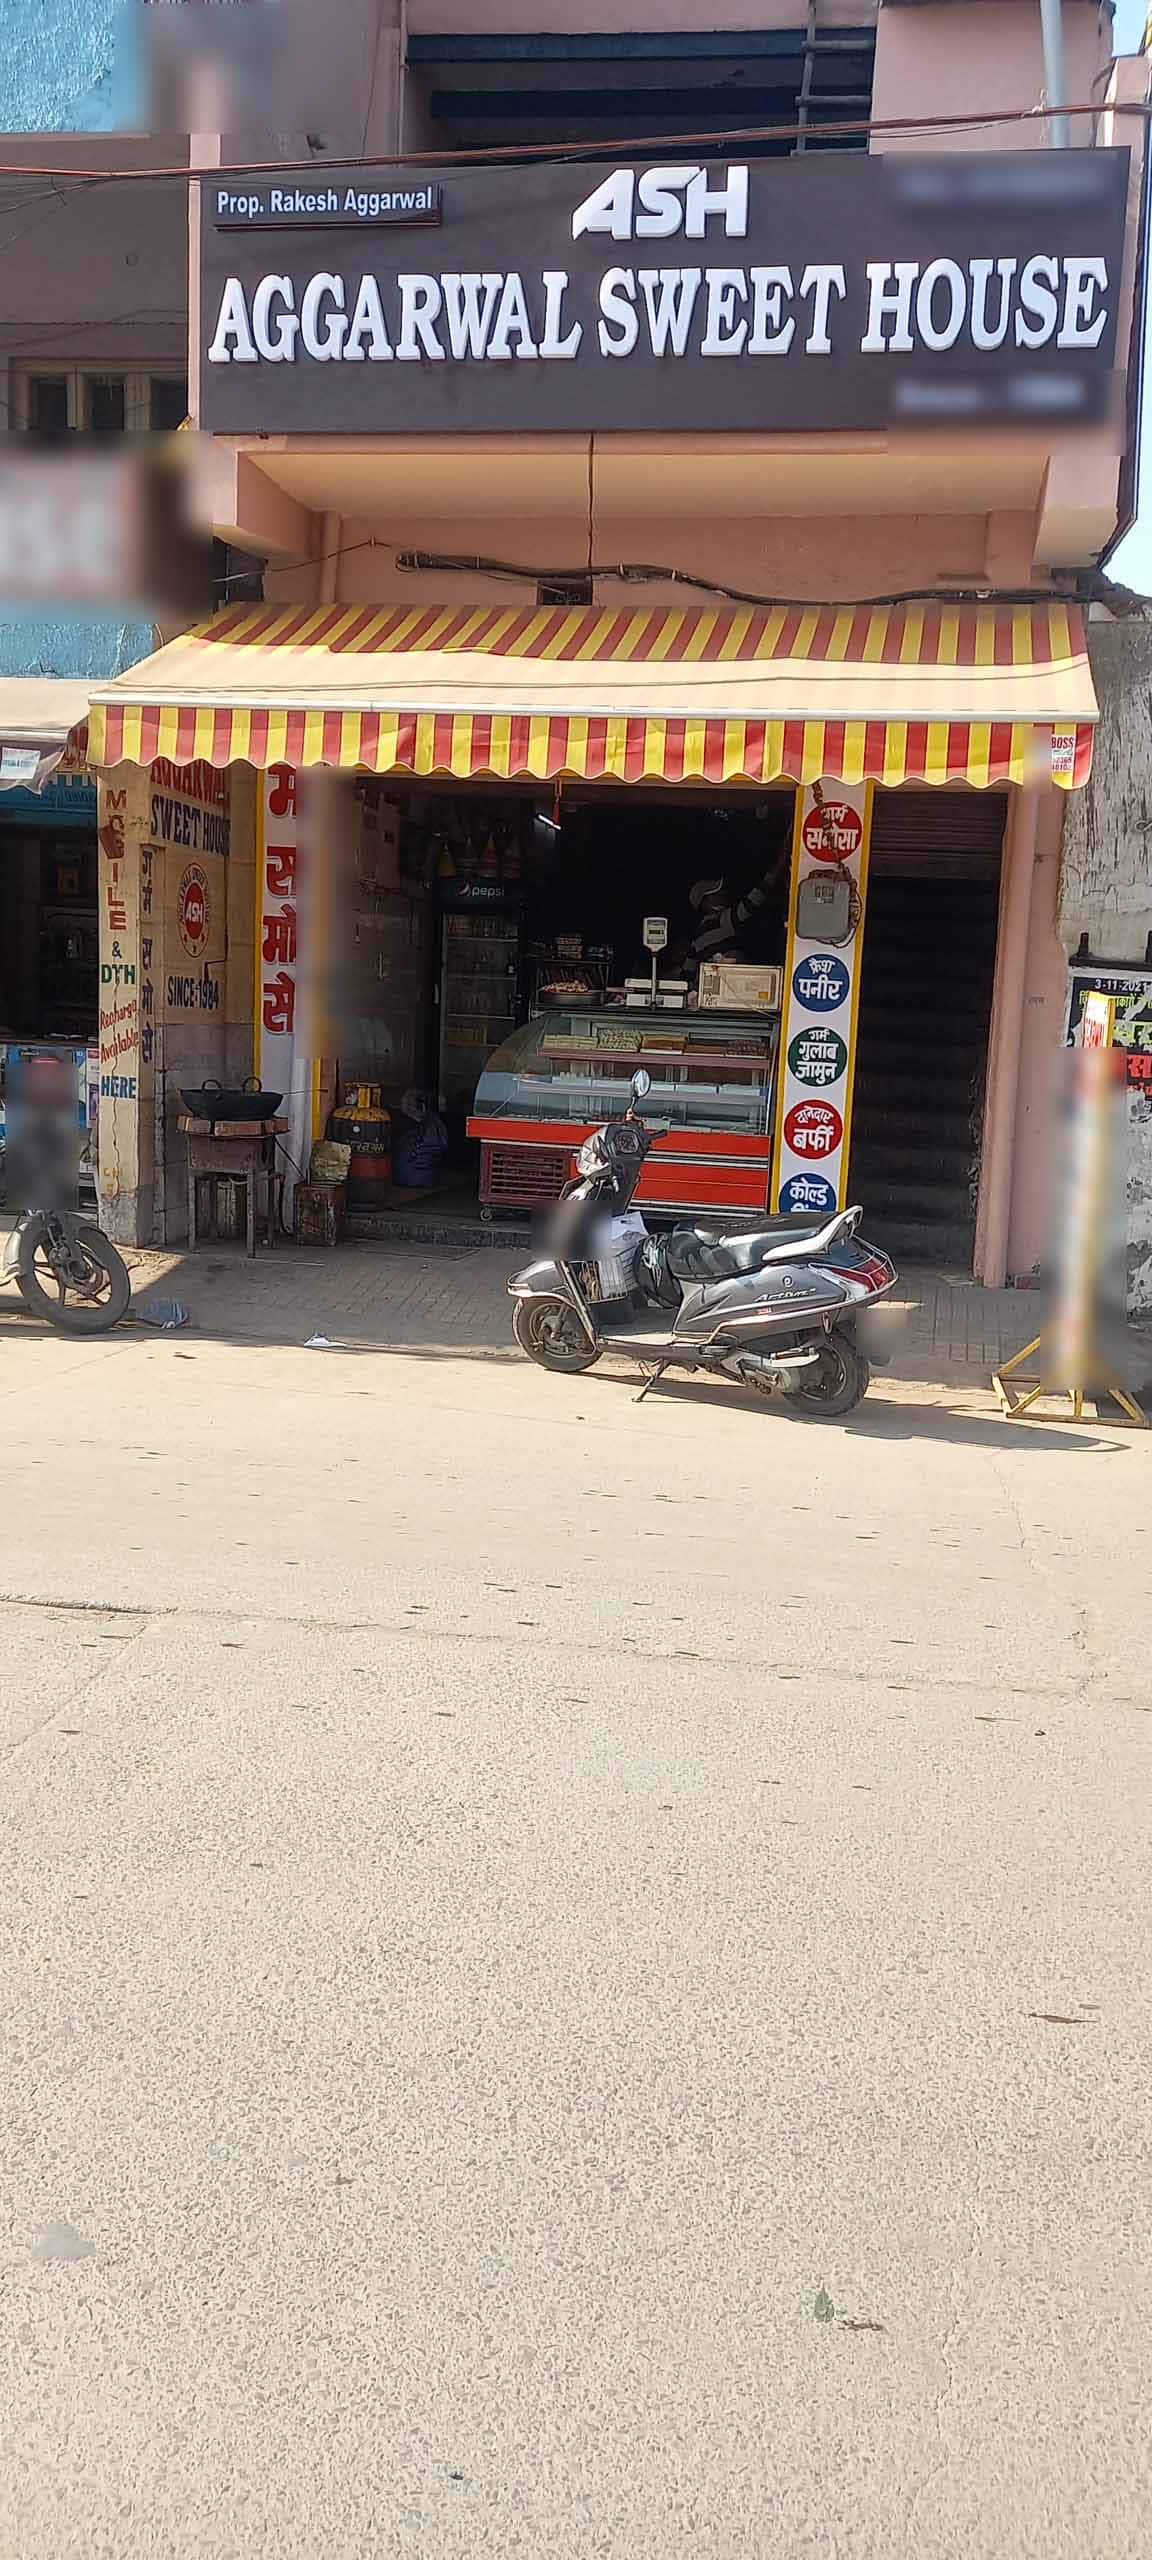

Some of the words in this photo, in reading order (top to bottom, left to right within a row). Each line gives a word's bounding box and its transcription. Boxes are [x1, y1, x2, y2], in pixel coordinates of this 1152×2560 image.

[217, 191, 264, 218] Prop.
[270, 189, 338, 212] Rakesh
[344, 186, 432, 216] Aggarwal
[572, 165, 749, 241] ASH
[208, 270, 582, 363] AGGARWAL
[598, 264, 846, 357] SWEET
[860, 254, 1108, 353] HOUSE
[151, 793, 202, 849] SWEET
[472, 885, 504, 899] pepsi
[112, 940, 123, 959] &
[798, 974, 843, 1000] पनीर
[808, 1029, 830, 1041] गर्म
[799, 1041, 839, 1061] गुलाब
[795, 1061, 838, 1084] जामुन
[101, 1074, 137, 1099] HERE
[789, 1177, 829, 1206] कोल्ड
